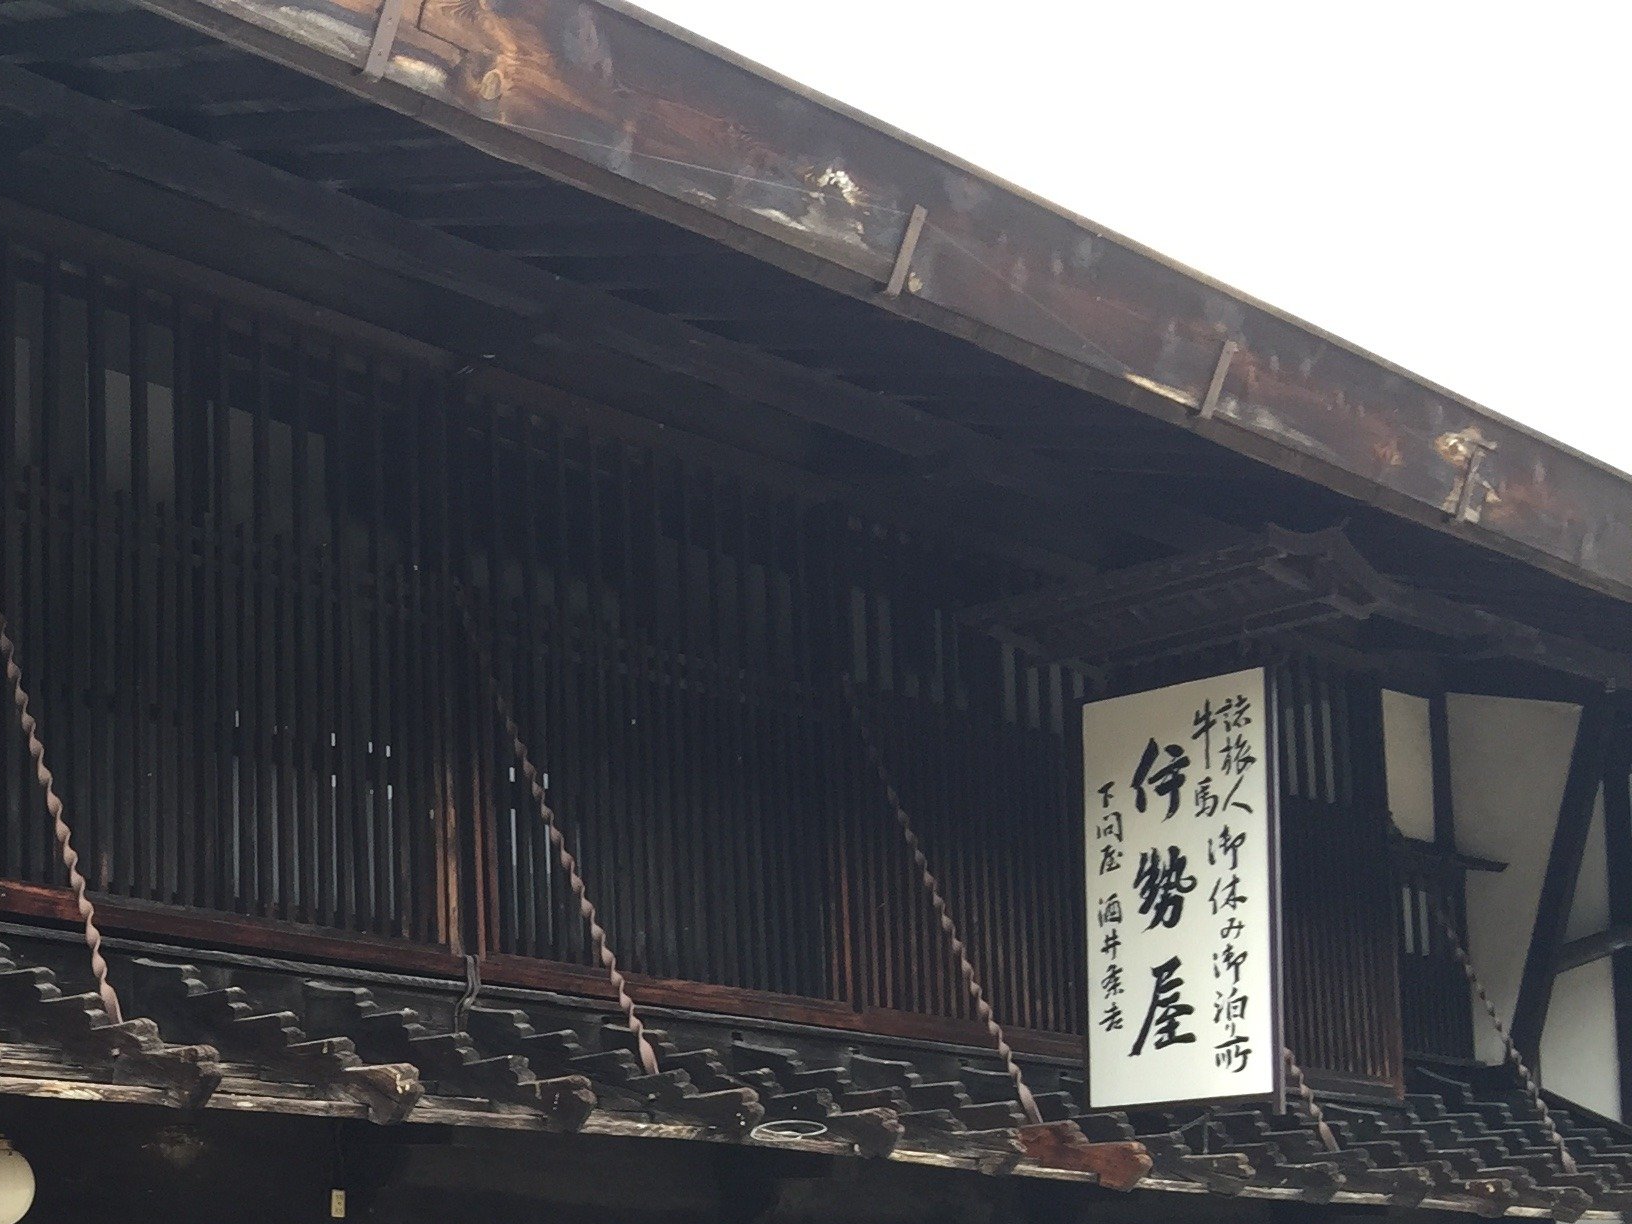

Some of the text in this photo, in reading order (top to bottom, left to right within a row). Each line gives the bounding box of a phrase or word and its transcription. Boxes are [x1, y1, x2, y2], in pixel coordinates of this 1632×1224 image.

[1191, 698, 1219, 818] 牛馬
[1096, 780, 1124, 876] 下問屋
[1128, 737, 1198, 1057] 伊勢屋
